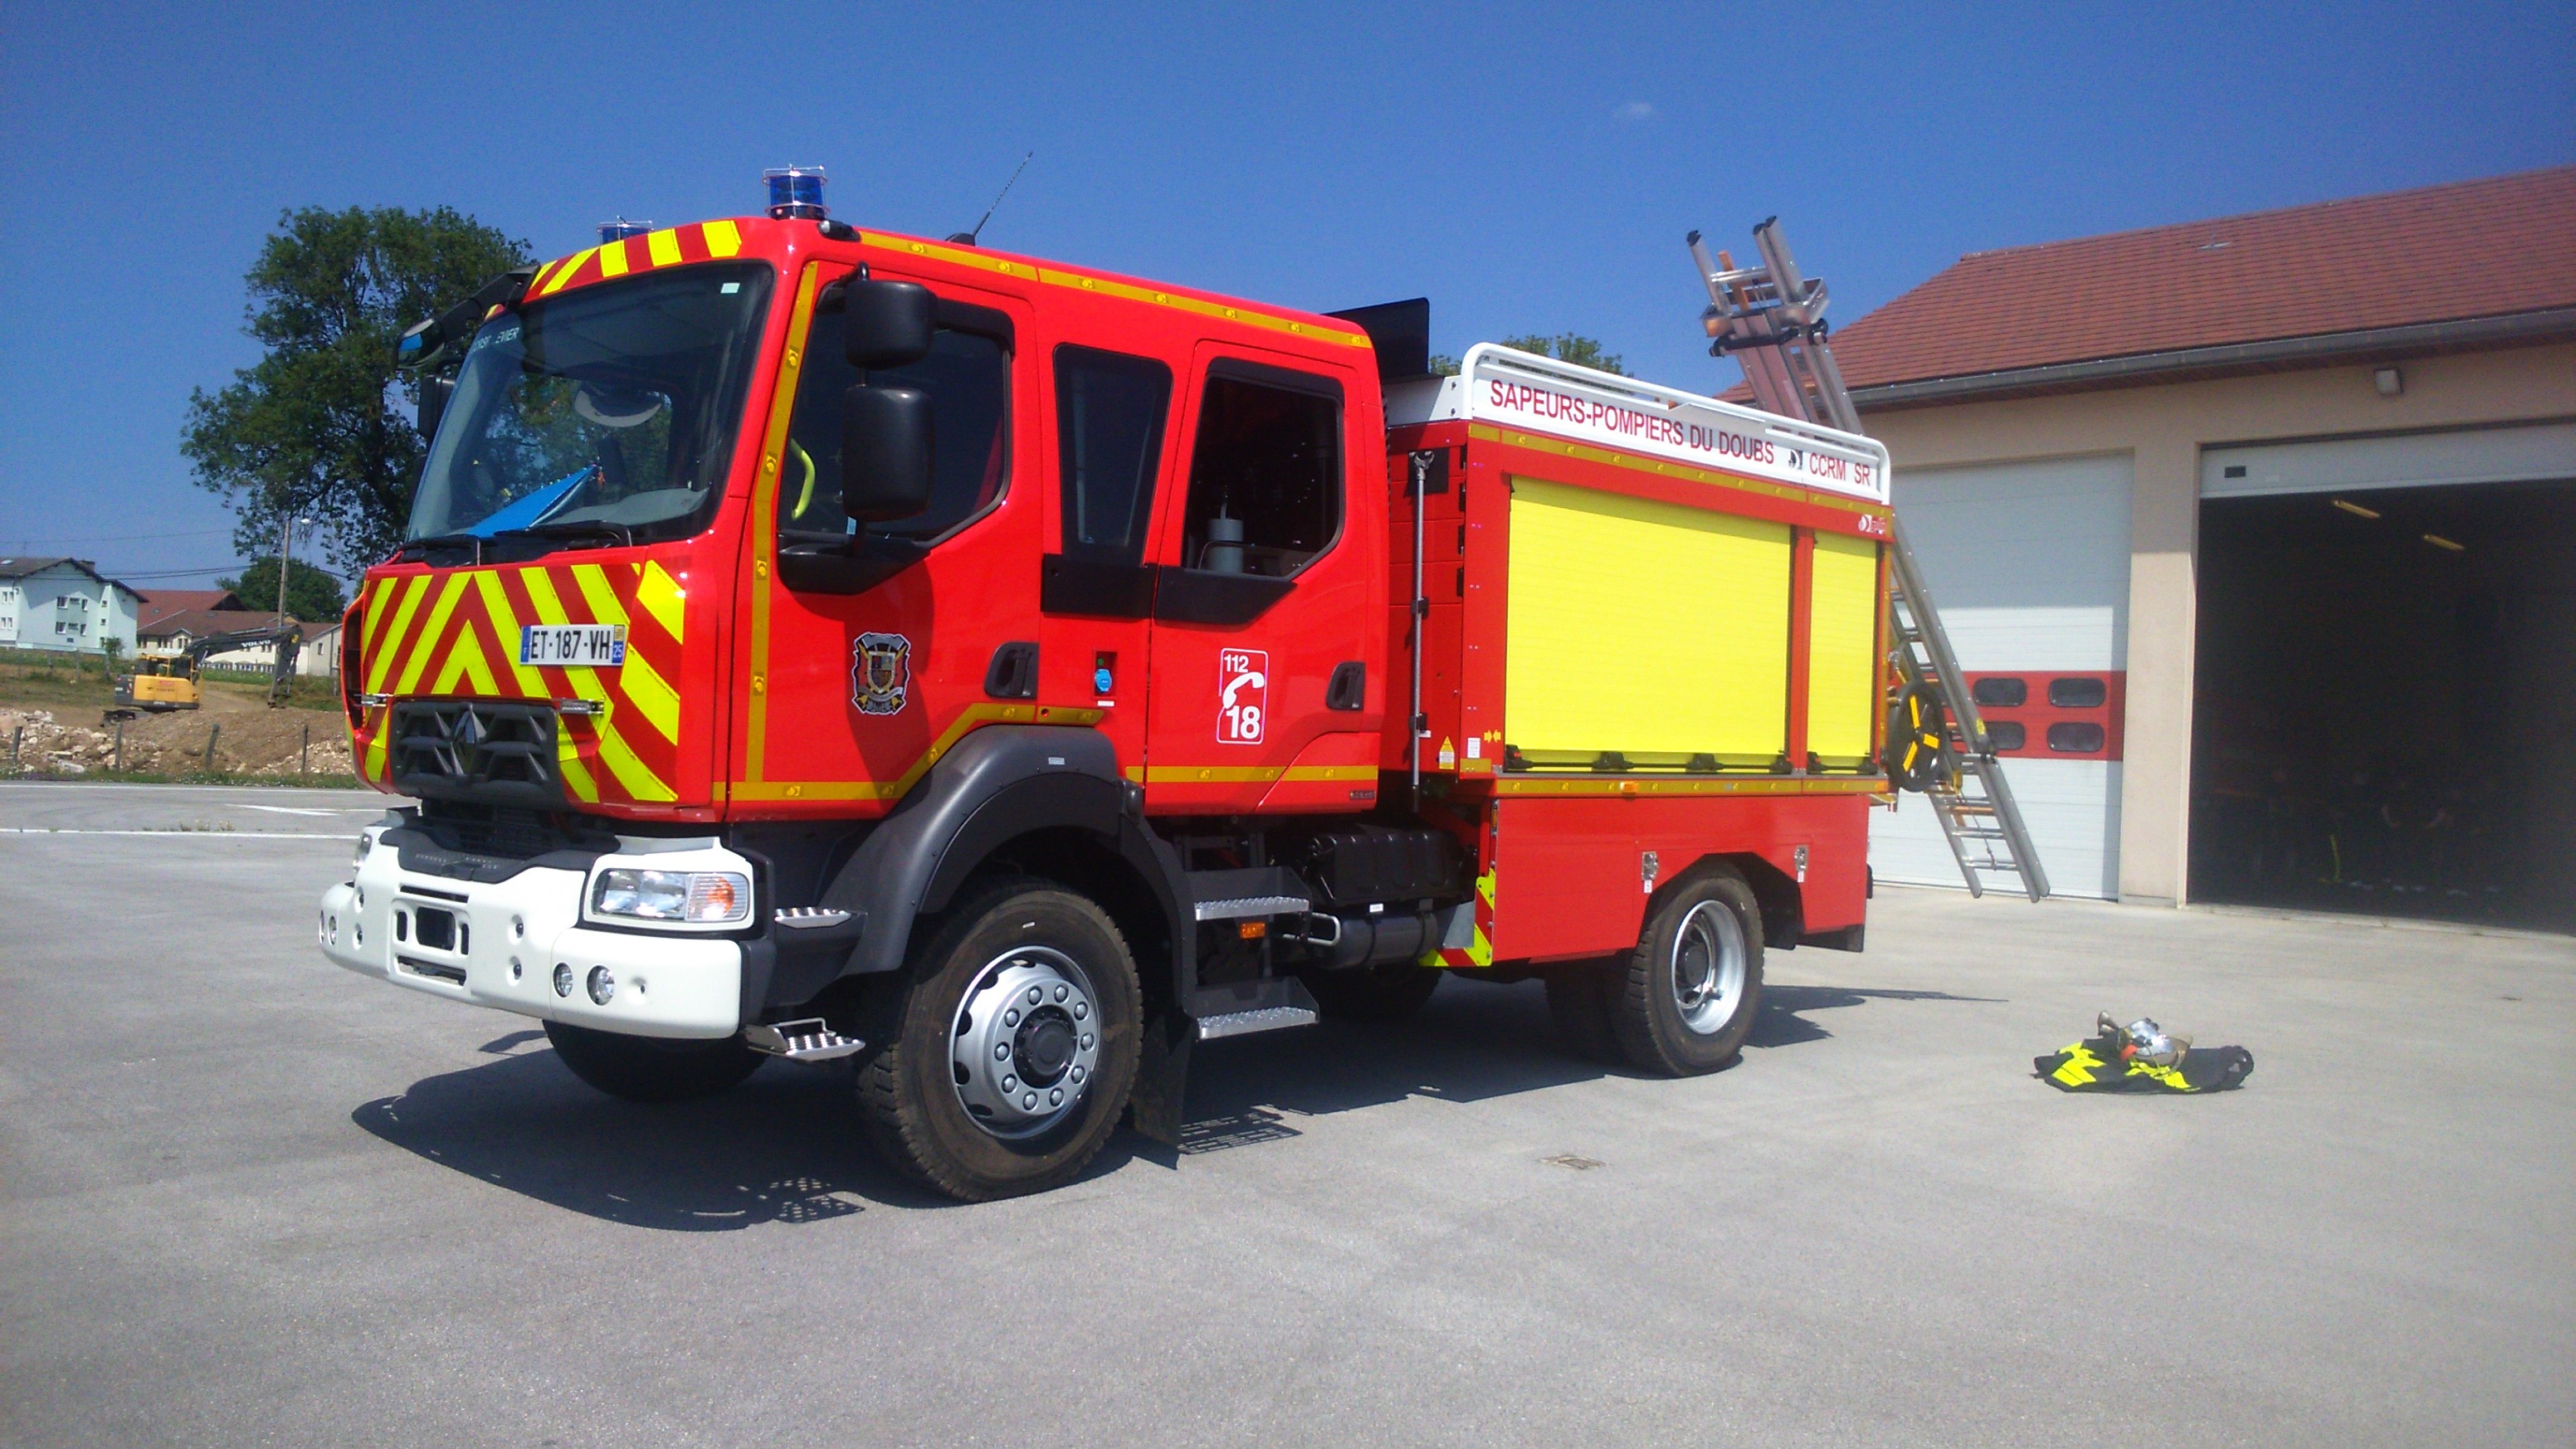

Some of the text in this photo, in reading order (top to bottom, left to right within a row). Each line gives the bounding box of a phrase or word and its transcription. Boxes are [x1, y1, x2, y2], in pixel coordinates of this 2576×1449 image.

[1490, 379, 1871, 486] SAPEURS-POMPIERS DU DOUBS CCRM SR
[241, 639, 271, 648] VOLVO
[612, 644, 623, 658] 25
[1224, 654, 1249, 673] 112
[1226, 705, 1261, 739] 18
